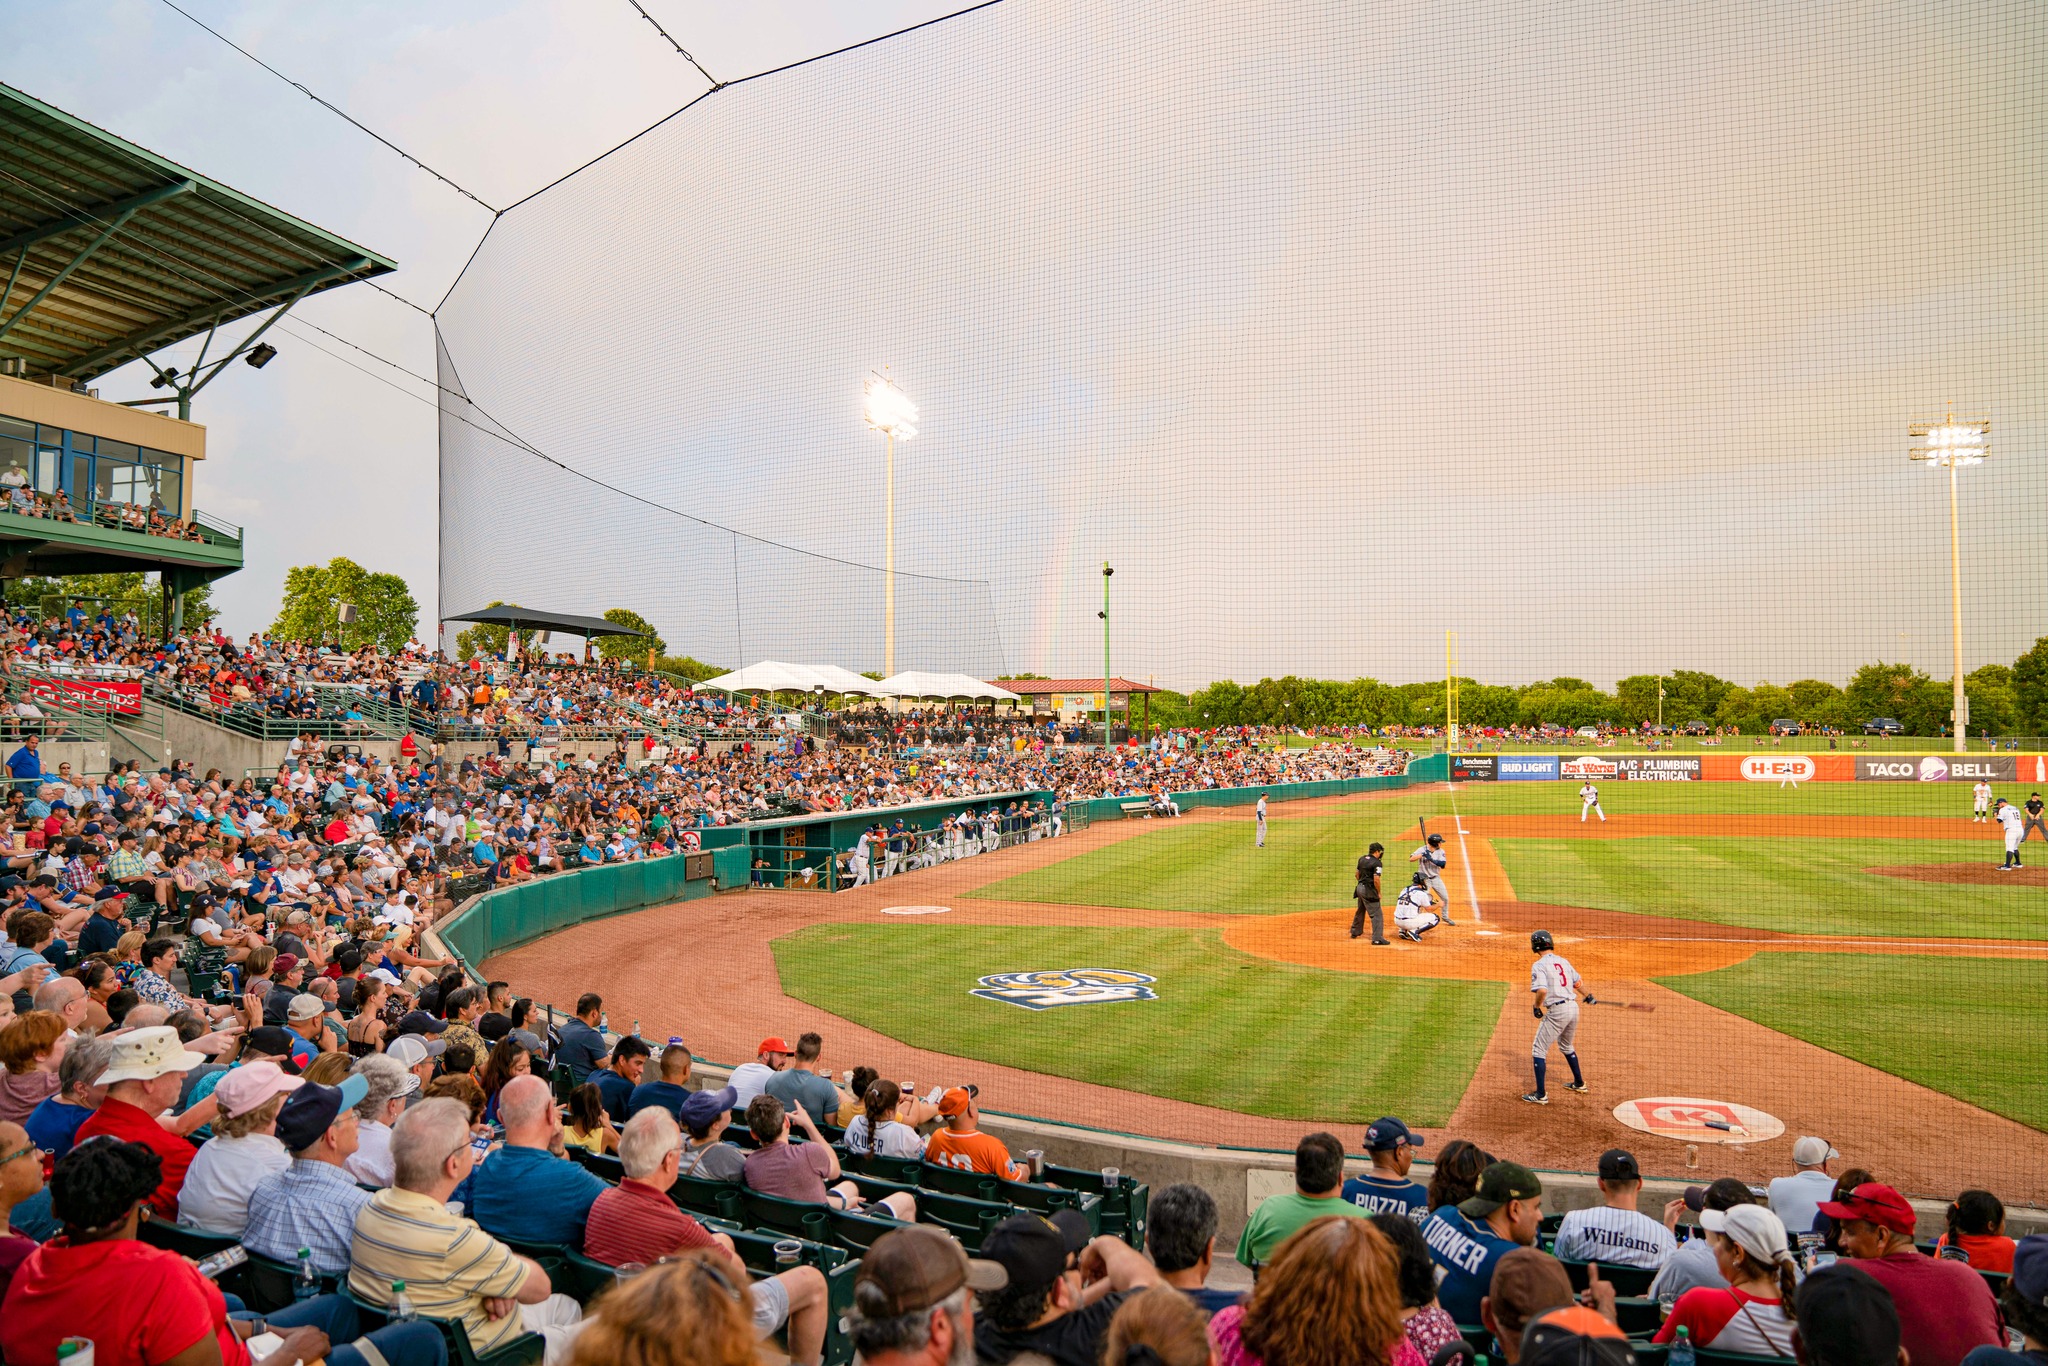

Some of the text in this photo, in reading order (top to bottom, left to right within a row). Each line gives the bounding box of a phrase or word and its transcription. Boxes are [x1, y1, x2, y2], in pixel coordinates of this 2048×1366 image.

[1501, 763, 1553, 772] BUD LIGHT
[1618, 760, 1699, 770] A/C PLUMBING
[1866, 763, 1996, 777] TACO BELL
[1627, 770, 1691, 781] ELECTRICAL
[1553, 963, 1567, 987] 3
[1670, 1110, 1711, 1123] K
[1422, 1214, 1489, 1275] TURNER
[1583, 1226, 1659, 1255] Williams
